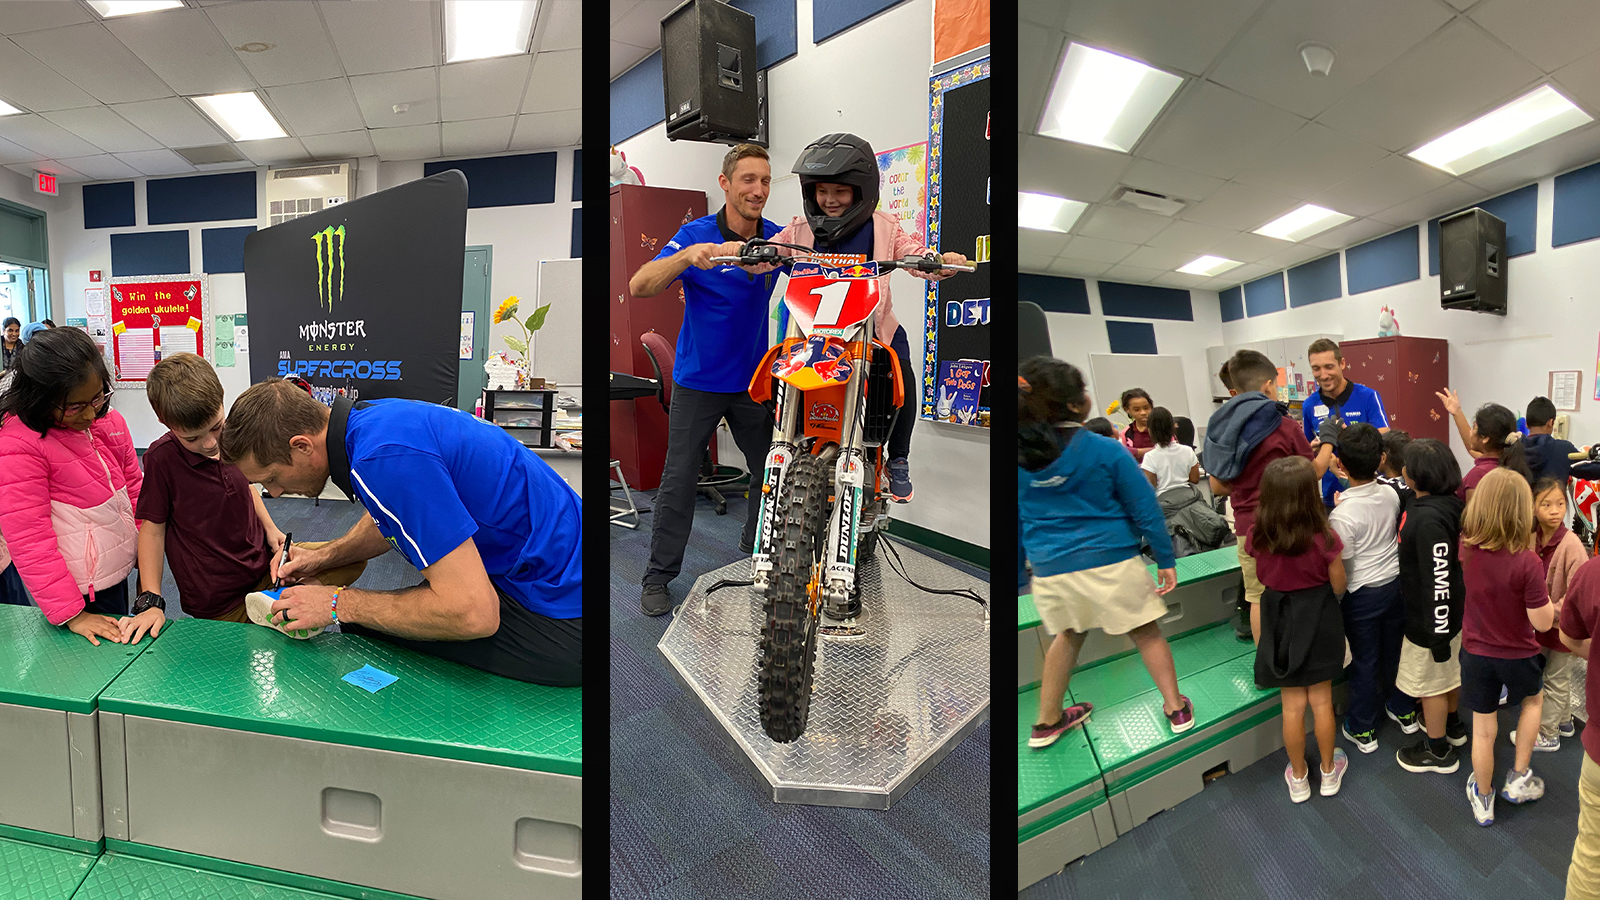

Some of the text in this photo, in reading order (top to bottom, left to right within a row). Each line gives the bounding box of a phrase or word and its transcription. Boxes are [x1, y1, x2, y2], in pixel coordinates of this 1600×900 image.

[38, 173, 56, 194] EXIT
[893, 185, 905, 196] the
[889, 198, 909, 209] world
[129, 291, 172, 301] Win the
[809, 281, 851, 325] 1
[121, 303, 189, 316] golden ukulele!
[946, 299, 990, 327] DET
[279, 350, 291, 360] AMA
[308, 343, 355, 352] ENERGY
[277, 360, 402, 380] SUPERCROSS
[762, 474, 778, 551] DNLOP
[840, 488, 854, 560] DUNLOP
[1432, 542, 1450, 634] GAME ON
